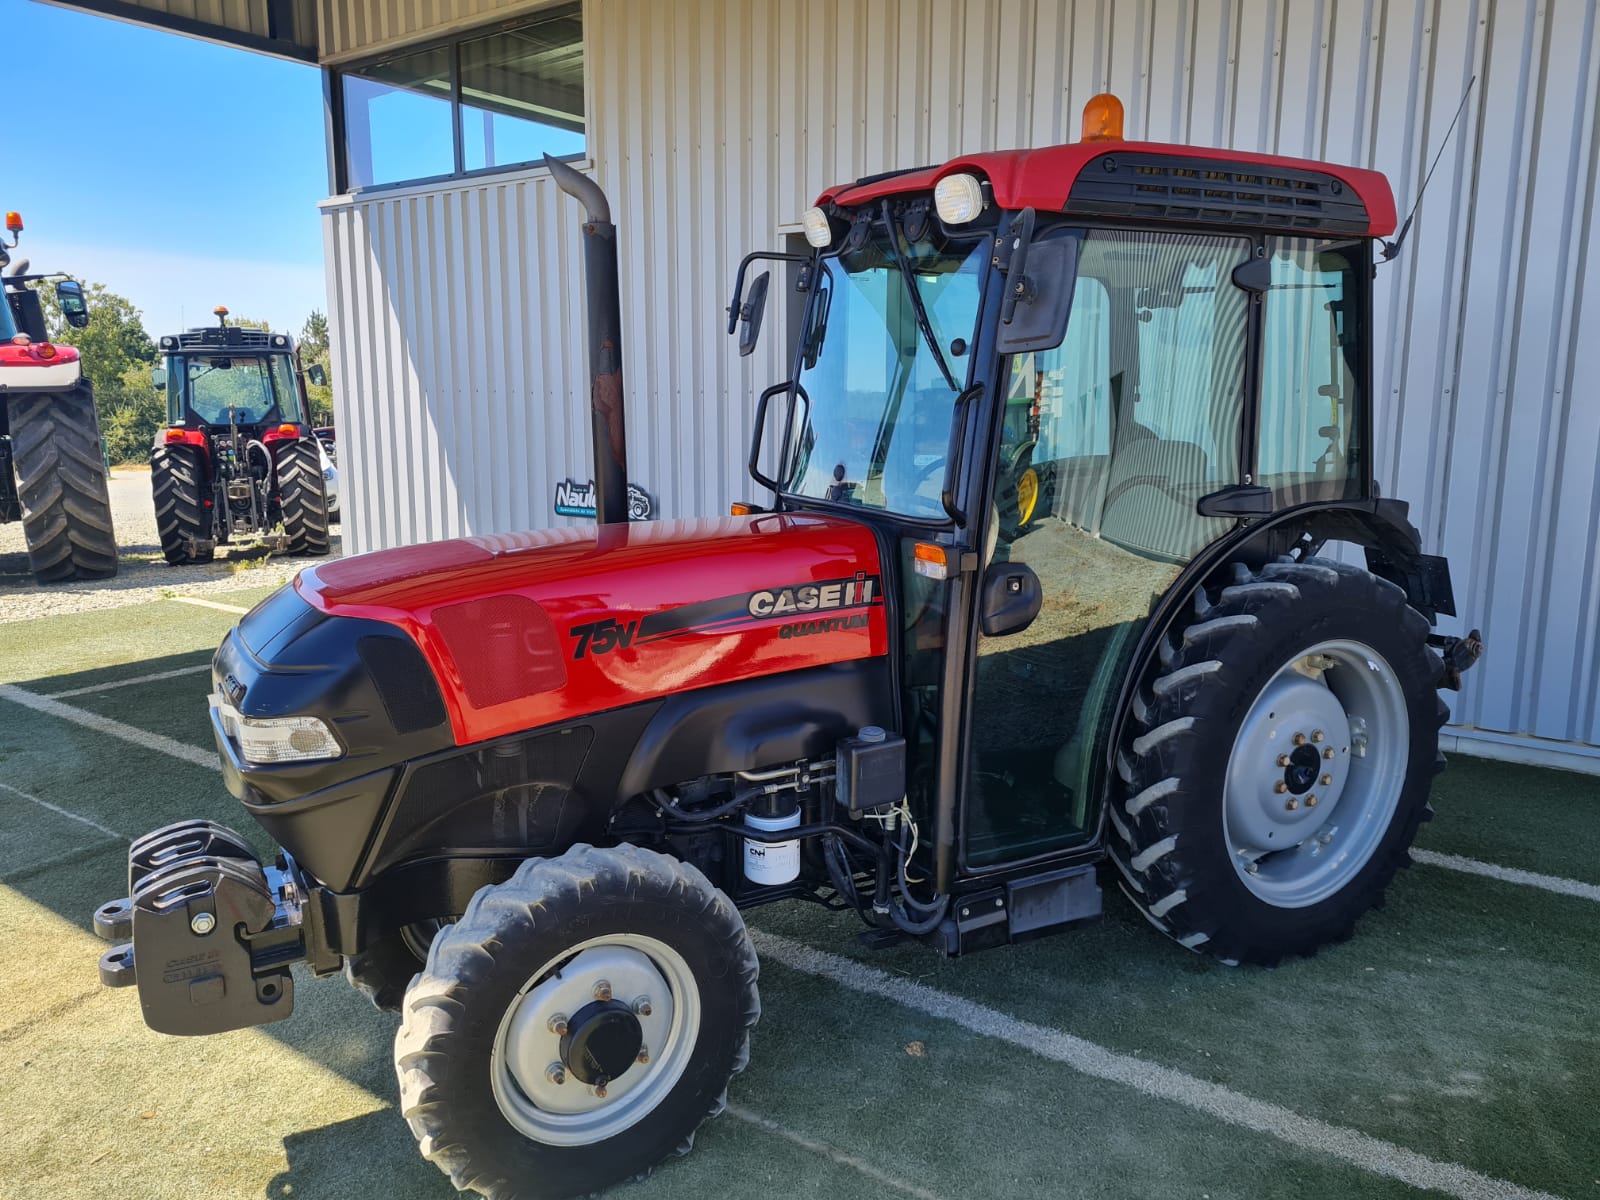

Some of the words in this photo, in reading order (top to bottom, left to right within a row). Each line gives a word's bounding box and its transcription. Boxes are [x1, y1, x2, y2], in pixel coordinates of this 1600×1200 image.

[748, 584, 842, 616] CASE
[569, 616, 636, 661] 75V
[778, 614, 871, 640] QUANTUM
[749, 848, 766, 857] CNH
